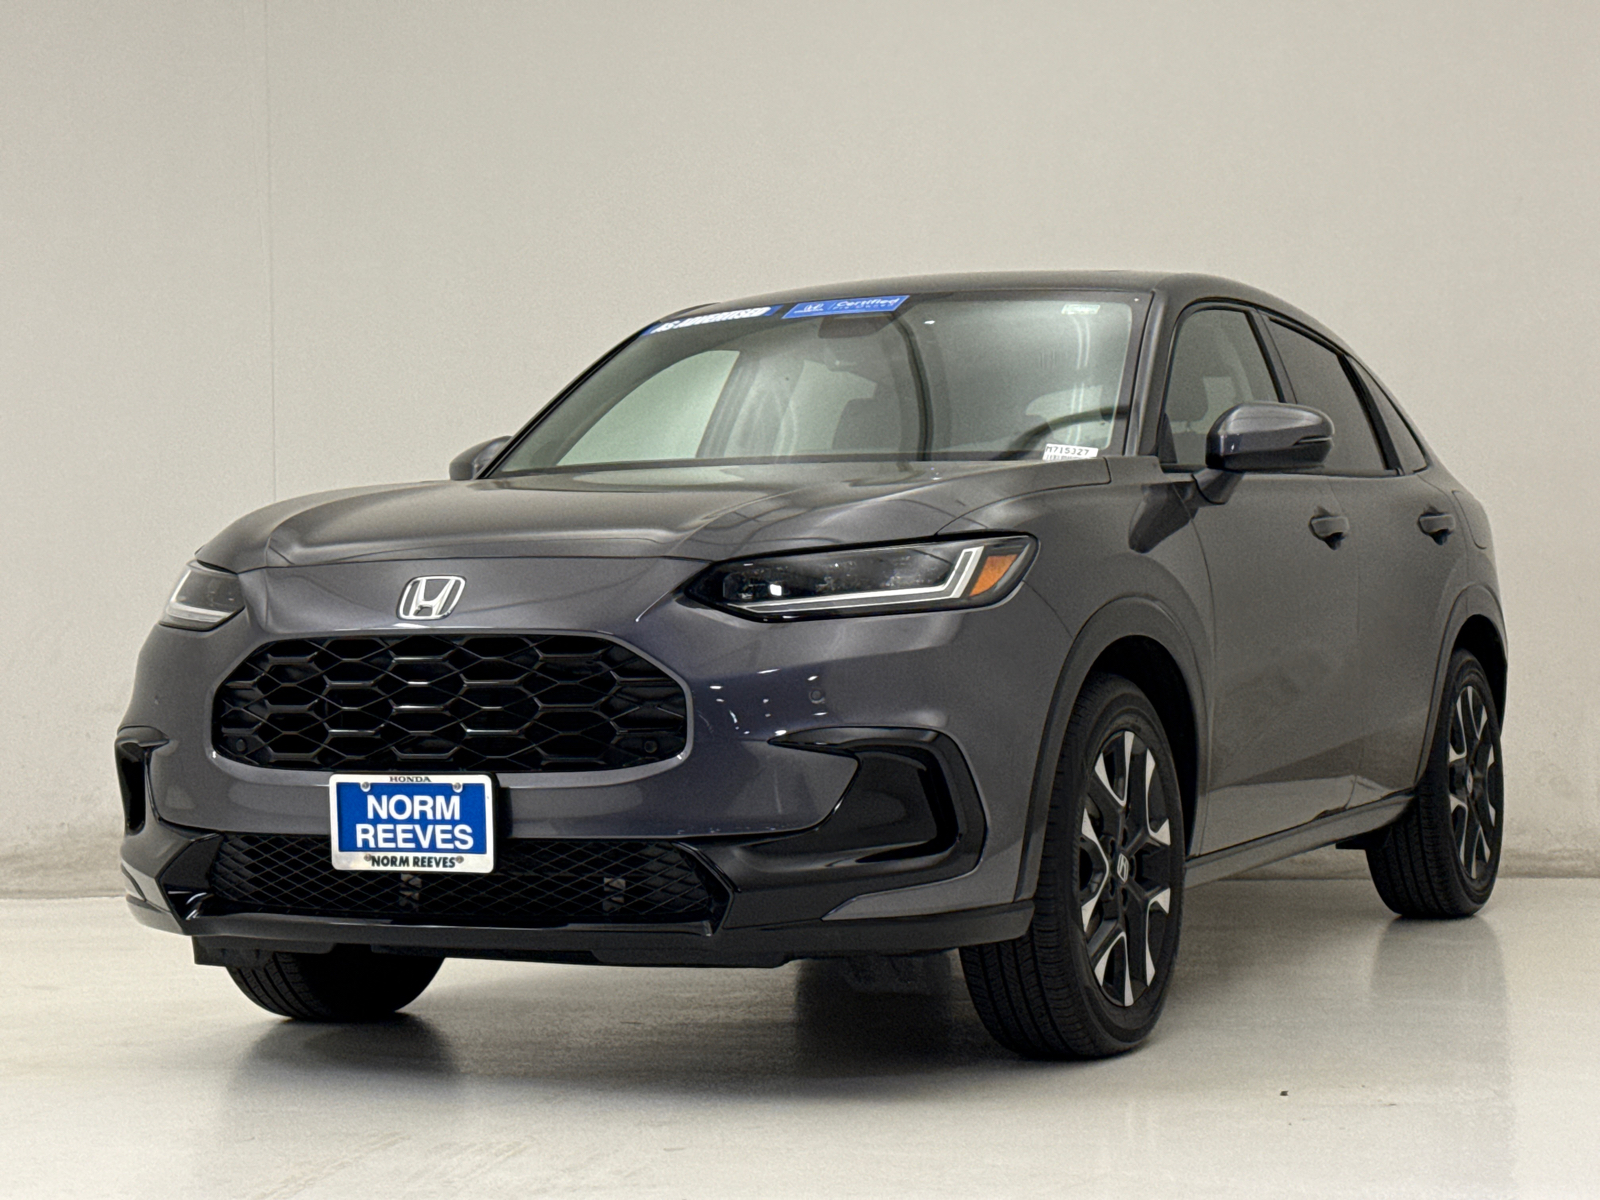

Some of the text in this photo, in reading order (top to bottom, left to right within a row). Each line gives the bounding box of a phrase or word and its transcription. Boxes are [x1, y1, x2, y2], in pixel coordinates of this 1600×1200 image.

[367, 794, 461, 821] NORM
[355, 823, 474, 850] REEVES
[371, 855, 456, 868] NORM REEVES
